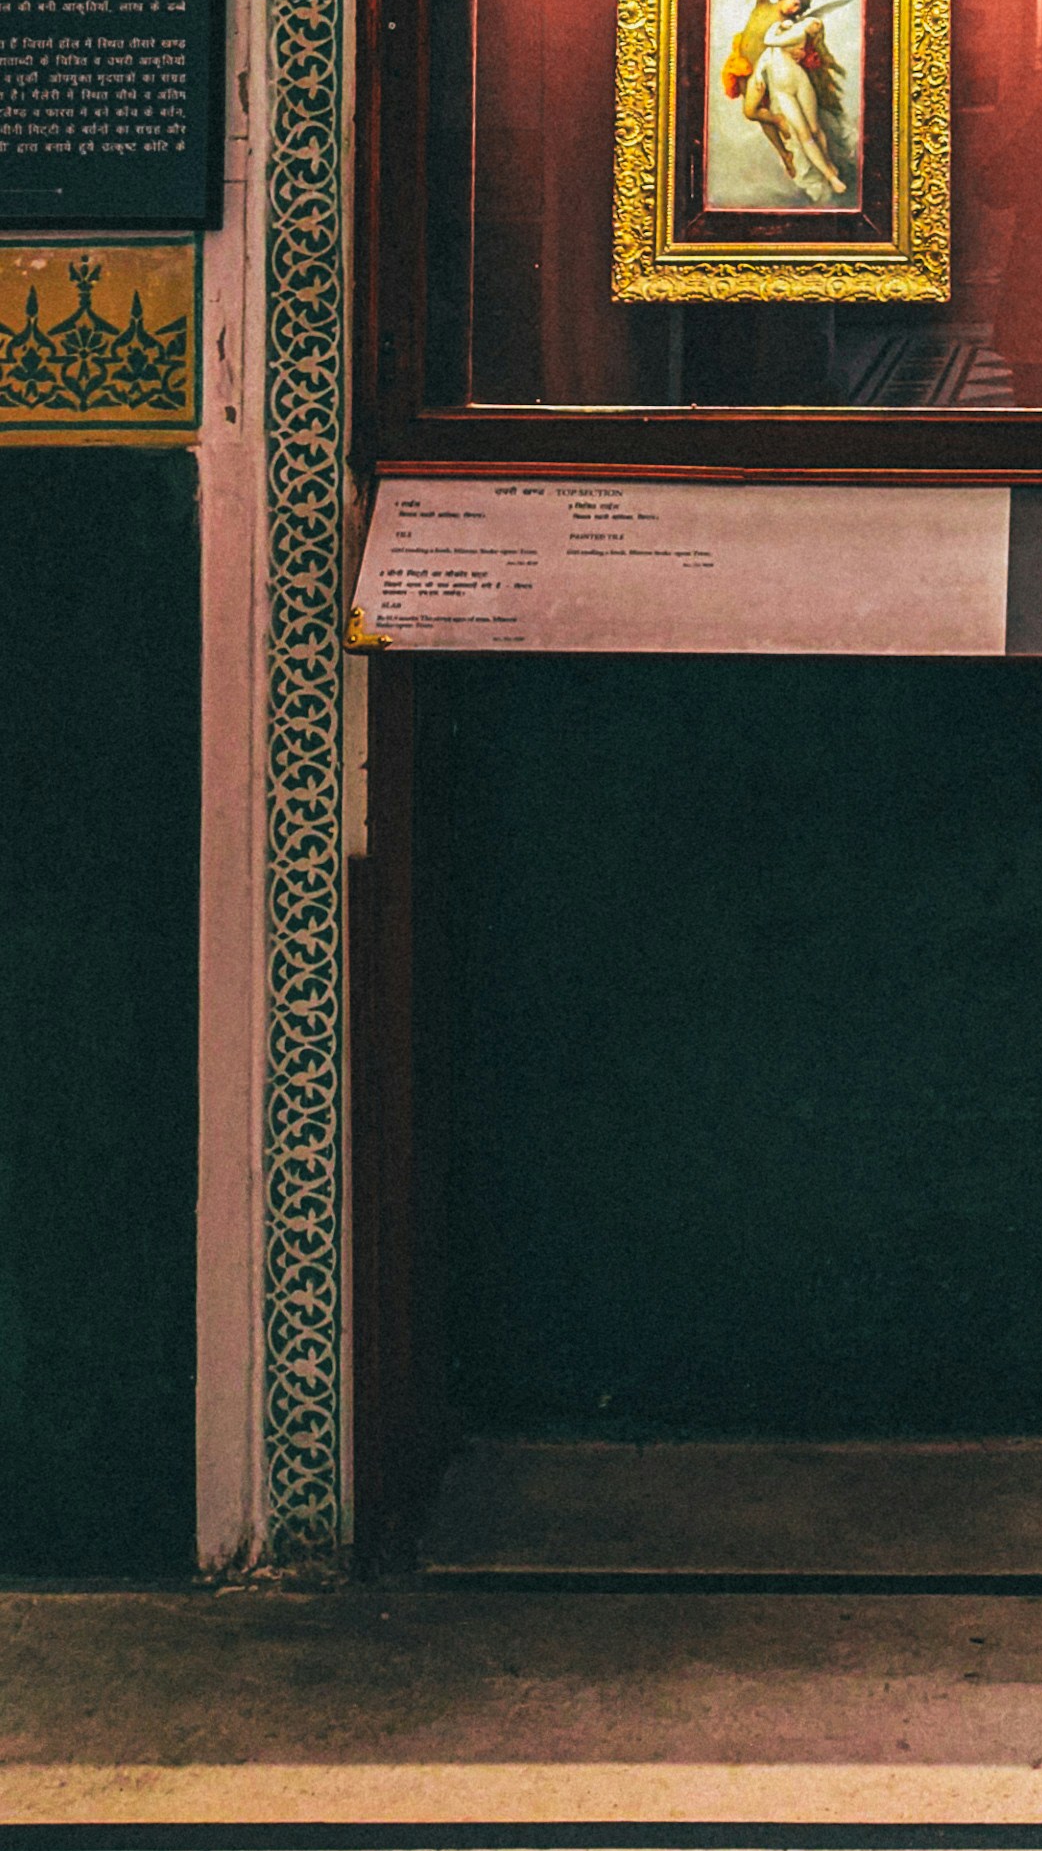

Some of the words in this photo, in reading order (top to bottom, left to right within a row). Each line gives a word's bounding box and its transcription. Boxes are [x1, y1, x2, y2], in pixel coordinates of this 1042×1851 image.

[17, 1, 31, 11] की
[142, 74, 155, 82] का
[115, 126, 129, 134] का
[166, 123, 186, 133] और
[16, 143, 38, 153] द्वारा
